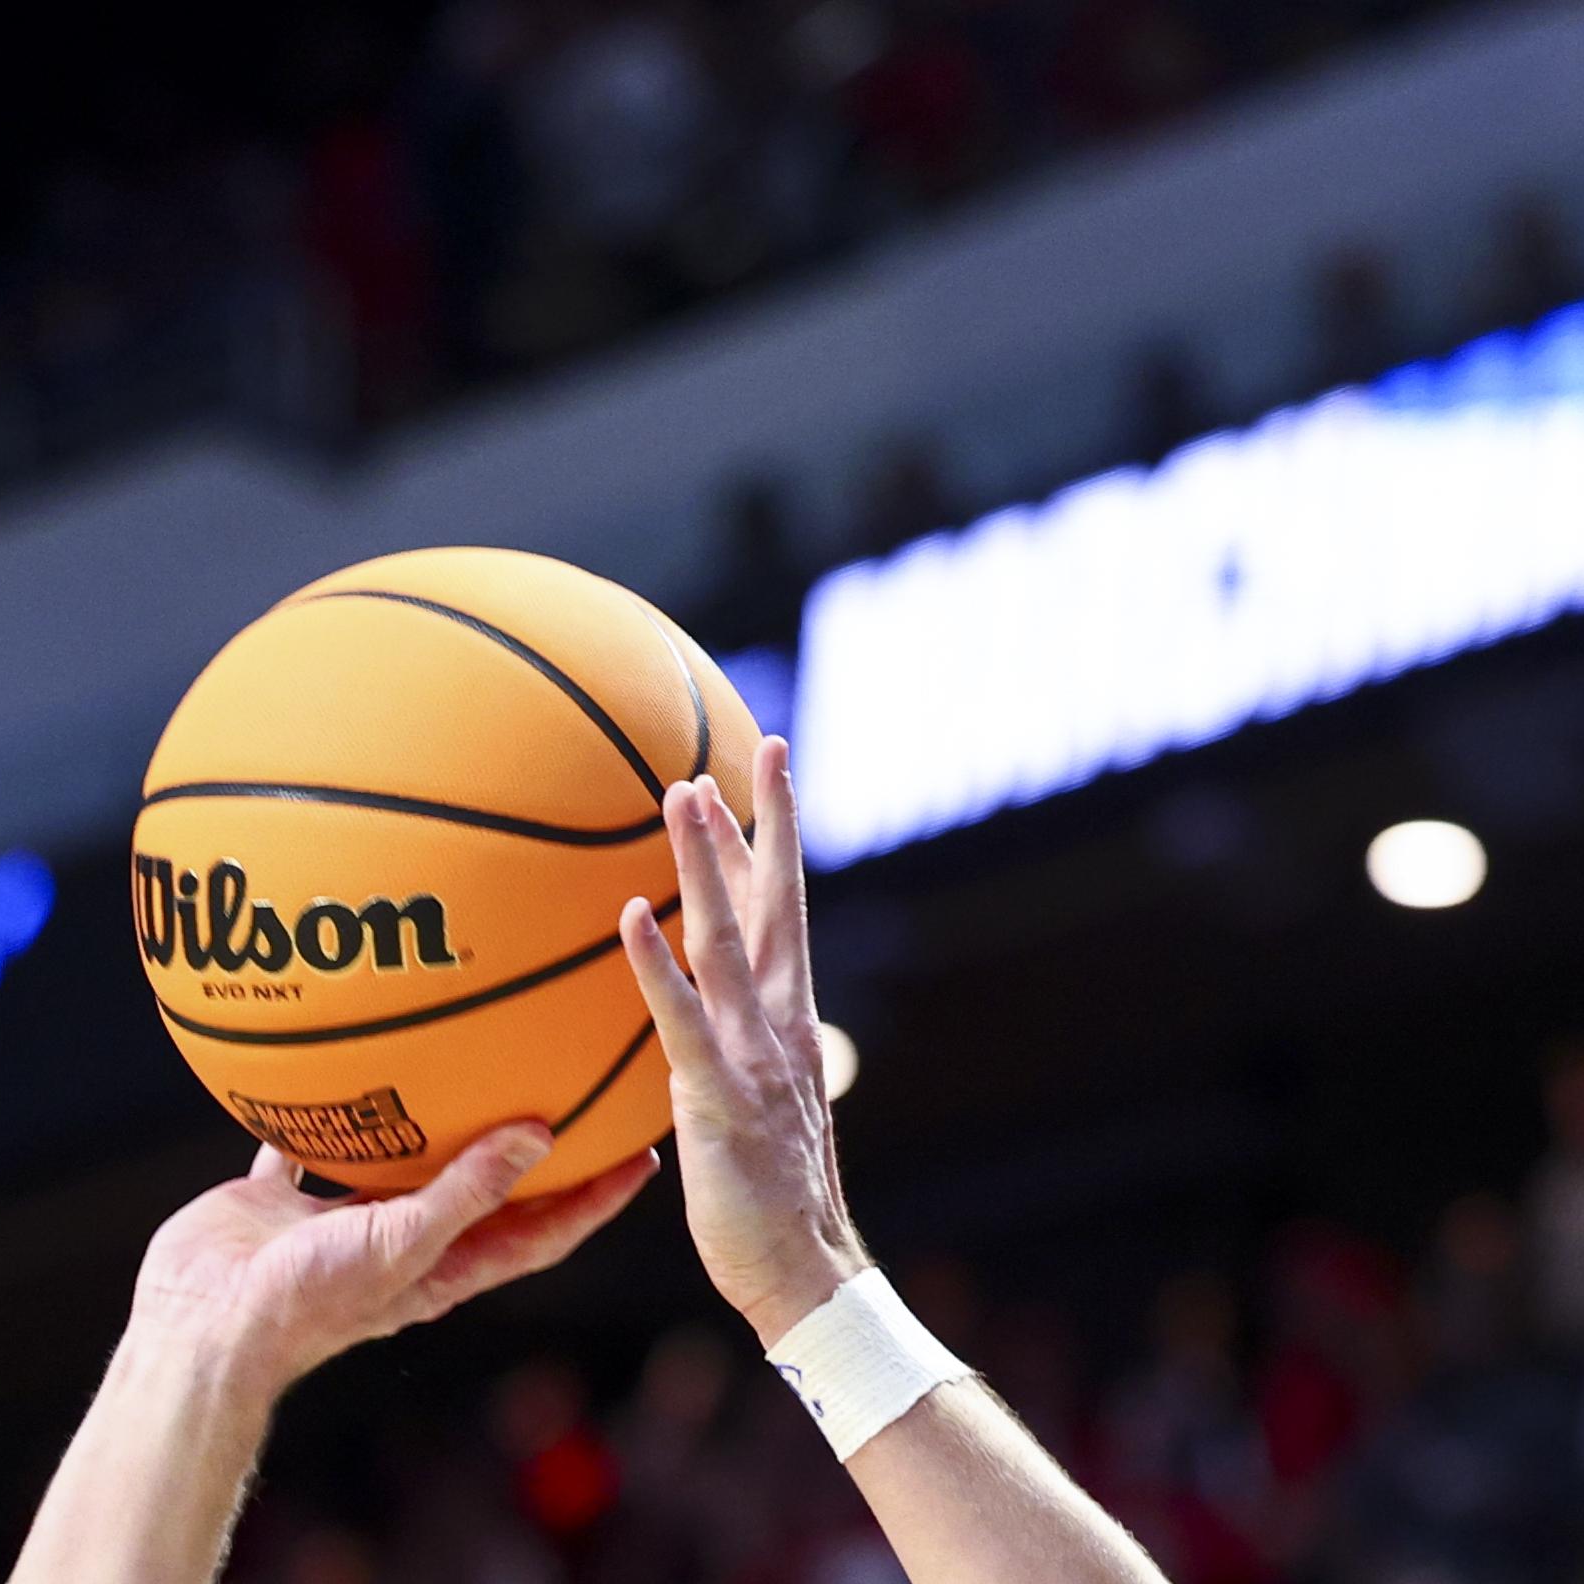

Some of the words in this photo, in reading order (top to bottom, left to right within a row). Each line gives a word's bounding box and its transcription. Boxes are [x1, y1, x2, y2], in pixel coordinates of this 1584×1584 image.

[134, 855, 457, 972] Wilson
[201, 982, 246, 1001] EVO
[251, 983, 304, 1002] NXT
